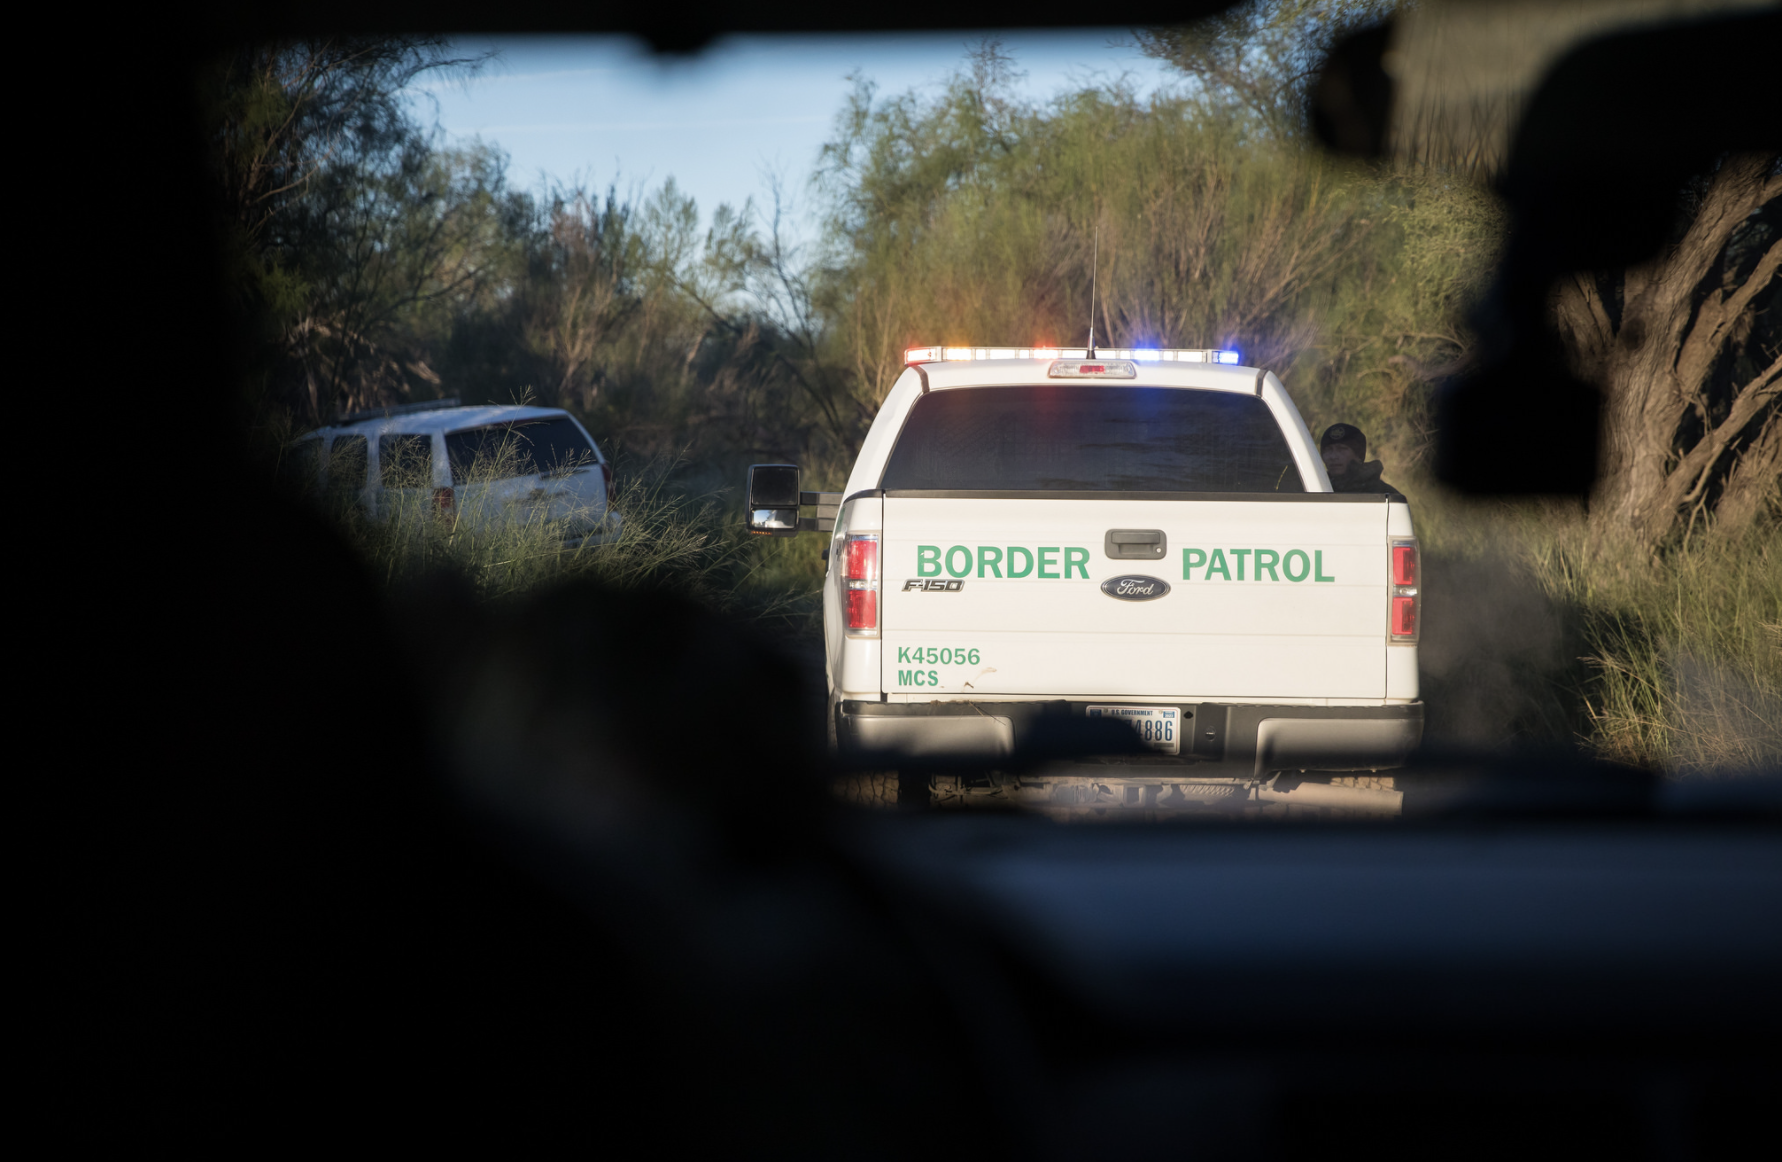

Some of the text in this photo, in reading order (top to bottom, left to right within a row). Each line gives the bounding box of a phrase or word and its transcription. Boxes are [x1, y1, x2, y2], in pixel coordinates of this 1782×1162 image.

[917, 545, 1336, 583] BORDER PATROL
[901, 579, 966, 592] F-150
[1116, 579, 1155, 595] Ford
[898, 646, 981, 665] K45056
[898, 670, 939, 686] MCS
[1125, 719, 1173, 741] 4886
